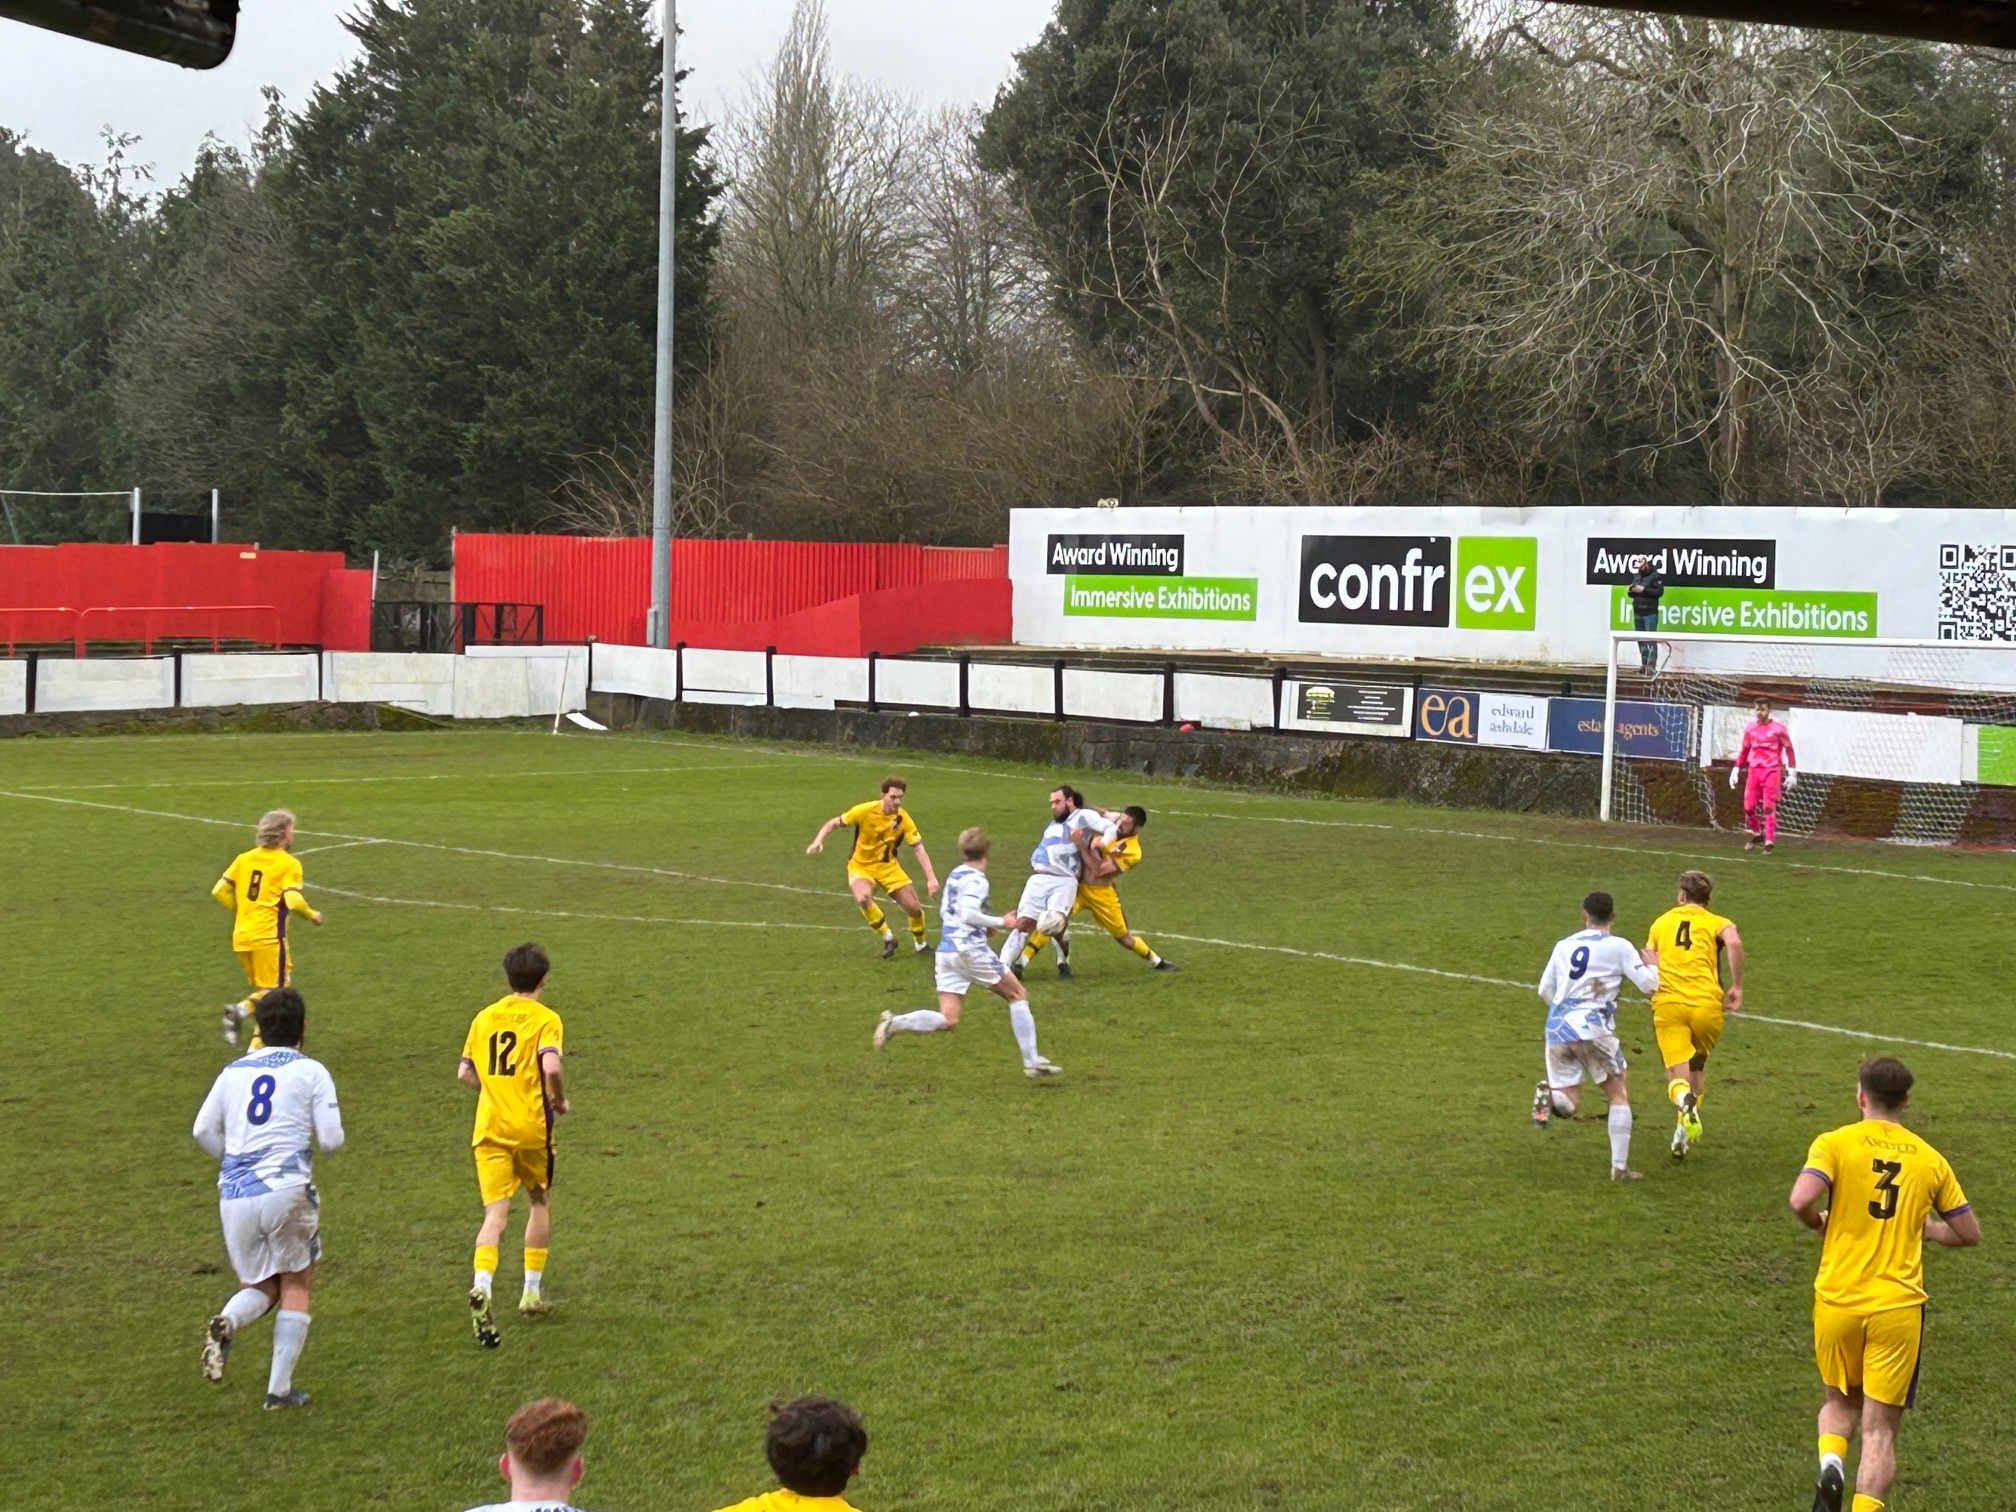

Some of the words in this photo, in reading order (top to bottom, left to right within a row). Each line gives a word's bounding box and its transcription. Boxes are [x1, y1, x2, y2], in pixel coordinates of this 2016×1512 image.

[1052, 543, 1106, 566] Award
[1110, 543, 1179, 572] Winning
[1672, 548, 1768, 583] Winning
[1070, 584, 1155, 609] Immersive
[1158, 586, 1251, 611] Exhibitions
[1740, 601, 1868, 631] Exhibitions
[1420, 694, 1474, 738] ea
[247, 869, 263, 902] 8
[1675, 920, 1693, 951] 4
[1569, 945, 1590, 980] 9
[487, 1030, 517, 1077] 12
[247, 1074, 276, 1126] 8
[1868, 1158, 1902, 1220] 3
